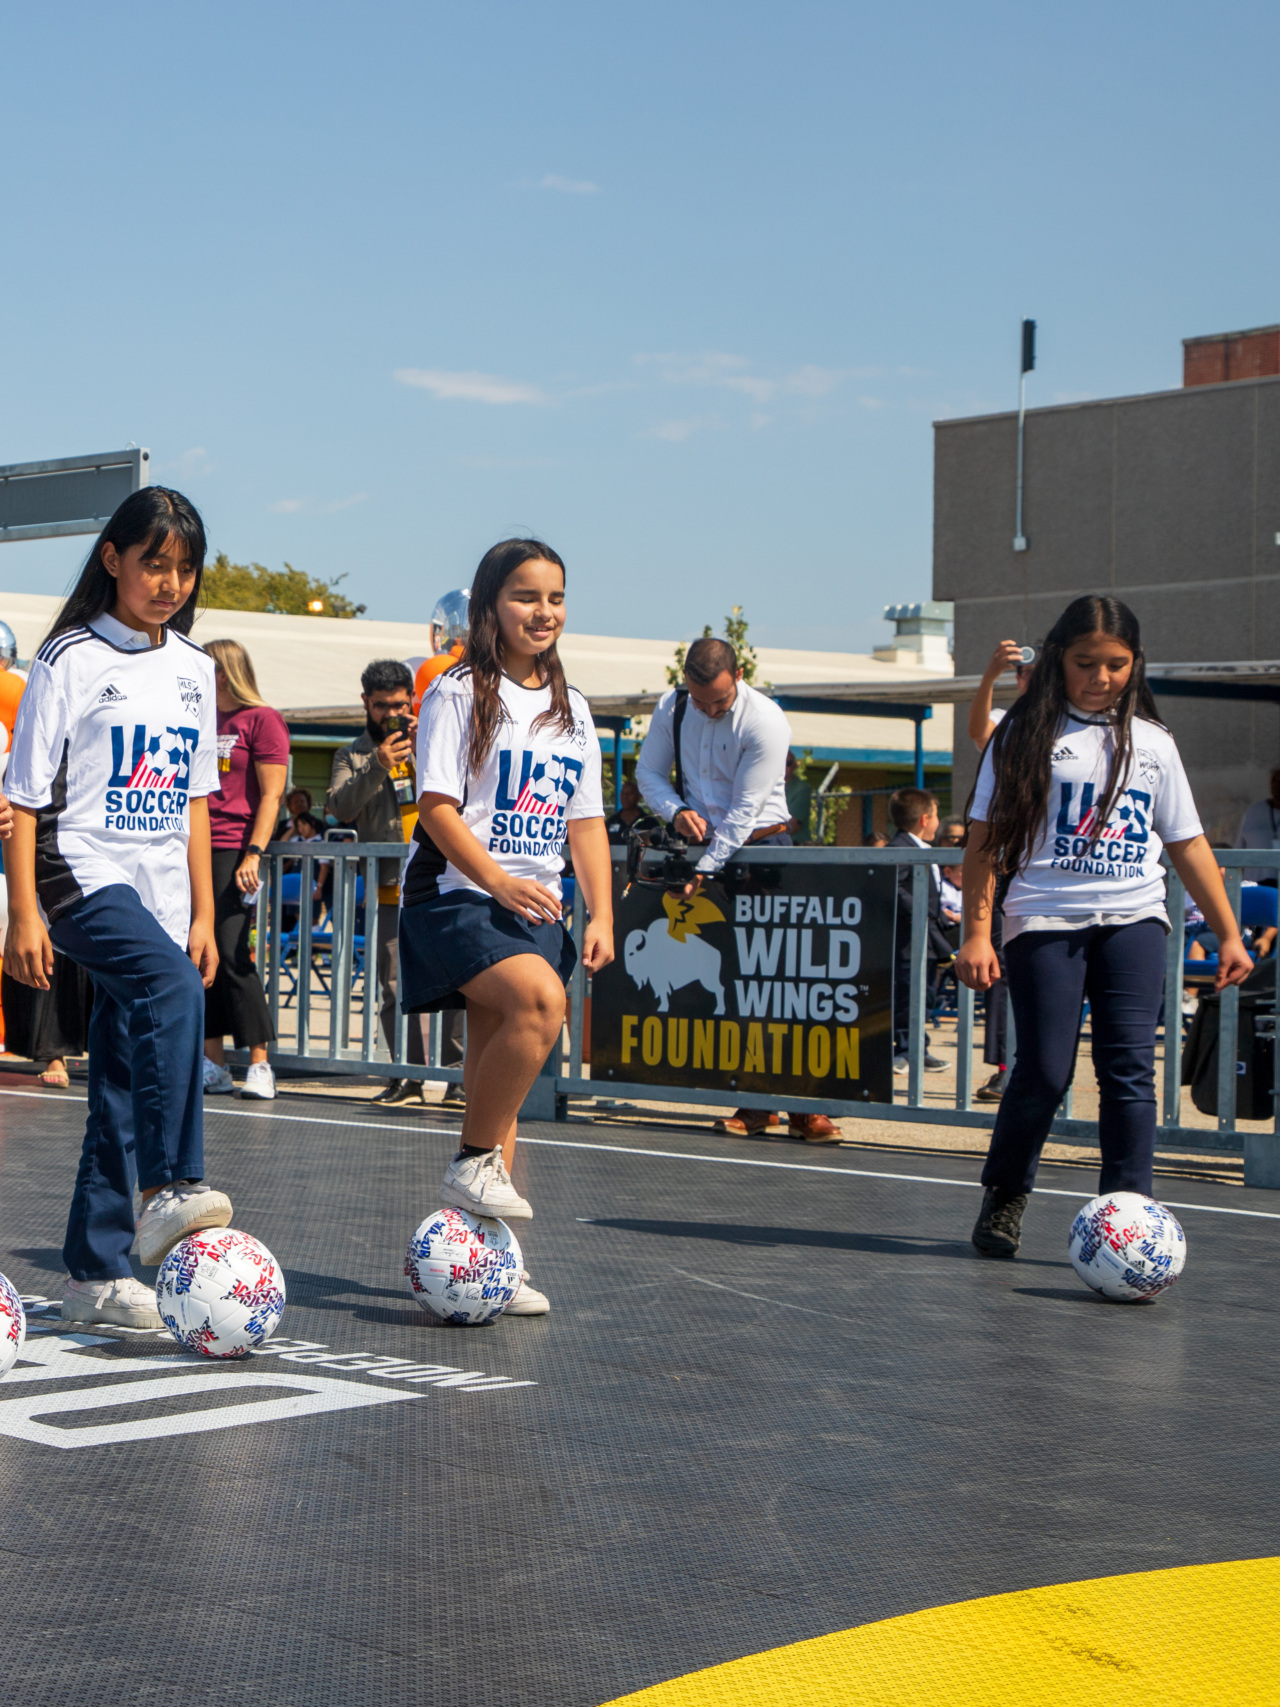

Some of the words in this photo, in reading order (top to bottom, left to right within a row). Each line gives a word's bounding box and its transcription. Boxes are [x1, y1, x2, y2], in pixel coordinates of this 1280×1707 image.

[98, 694, 128, 704] adidas
[105, 790, 188, 815] SOCCER
[1054, 836, 1147, 864] SOCCER
[1050, 858, 1145, 877] FOUNDATION
[735, 895, 862, 925] BUFFALO
[734, 927, 861, 979] WILD
[734, 979, 859, 1023] WINGS
[621, 1014, 860, 1080] FOUNDATION
[1138, 1239, 1174, 1271] MAJOR
